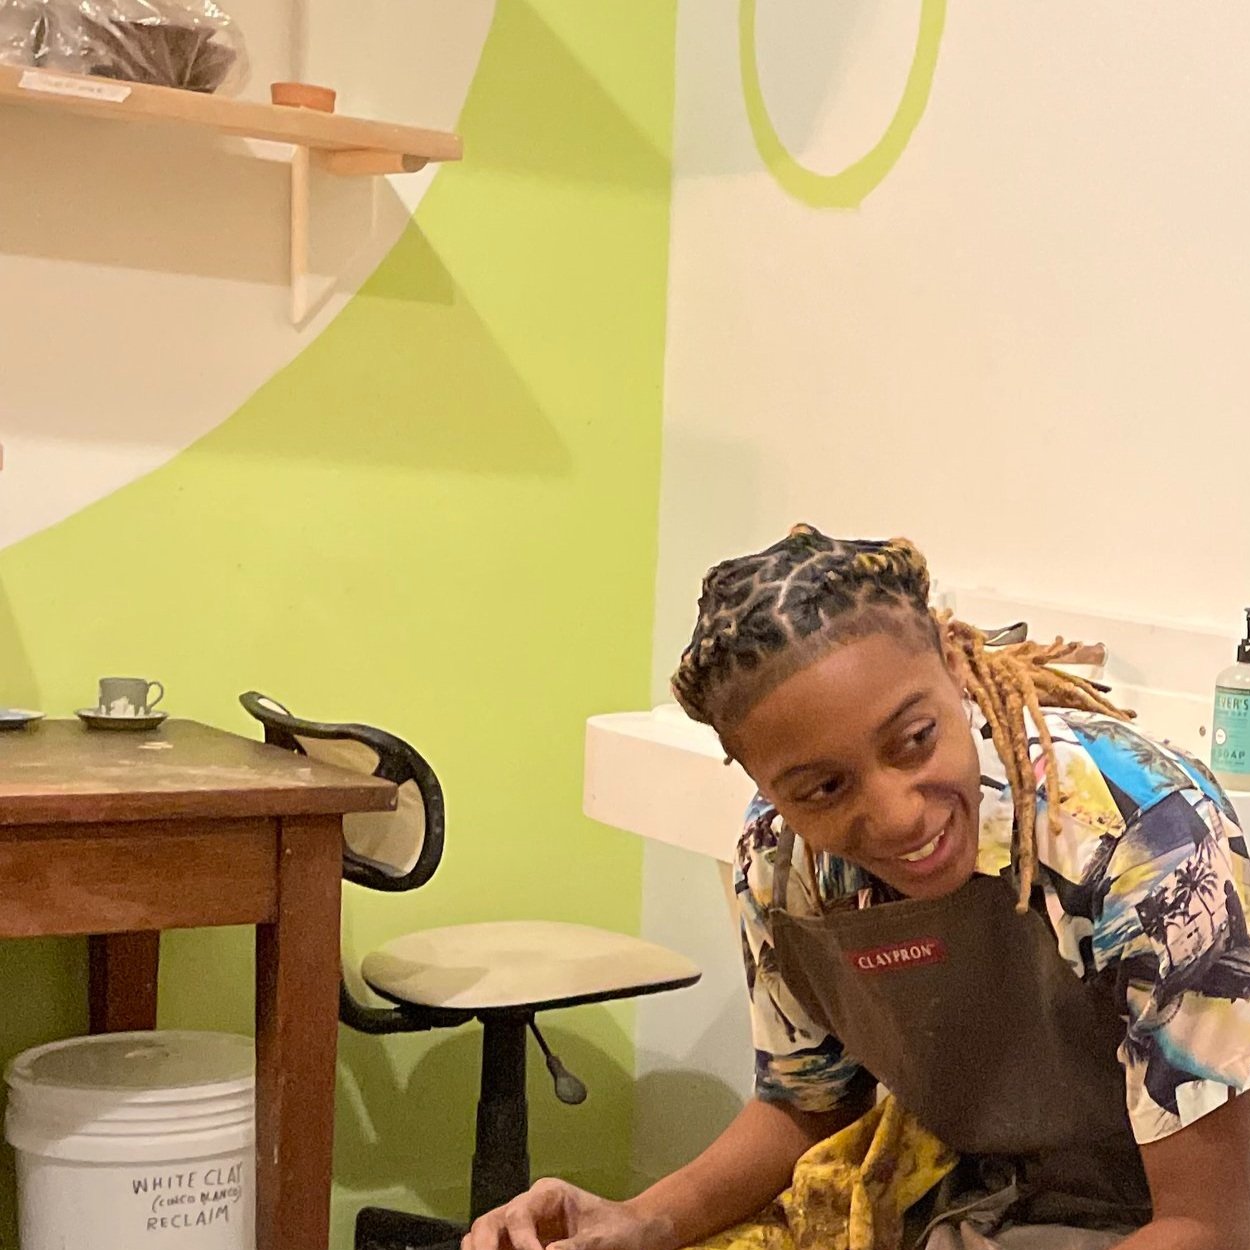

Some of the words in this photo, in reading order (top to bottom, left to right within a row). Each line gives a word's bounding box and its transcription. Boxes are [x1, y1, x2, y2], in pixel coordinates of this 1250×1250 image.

[132, 1171, 197, 1195] WHITE
[204, 1161, 243, 1187] CLAY
[146, 1204, 229, 1231] RECLAIM
